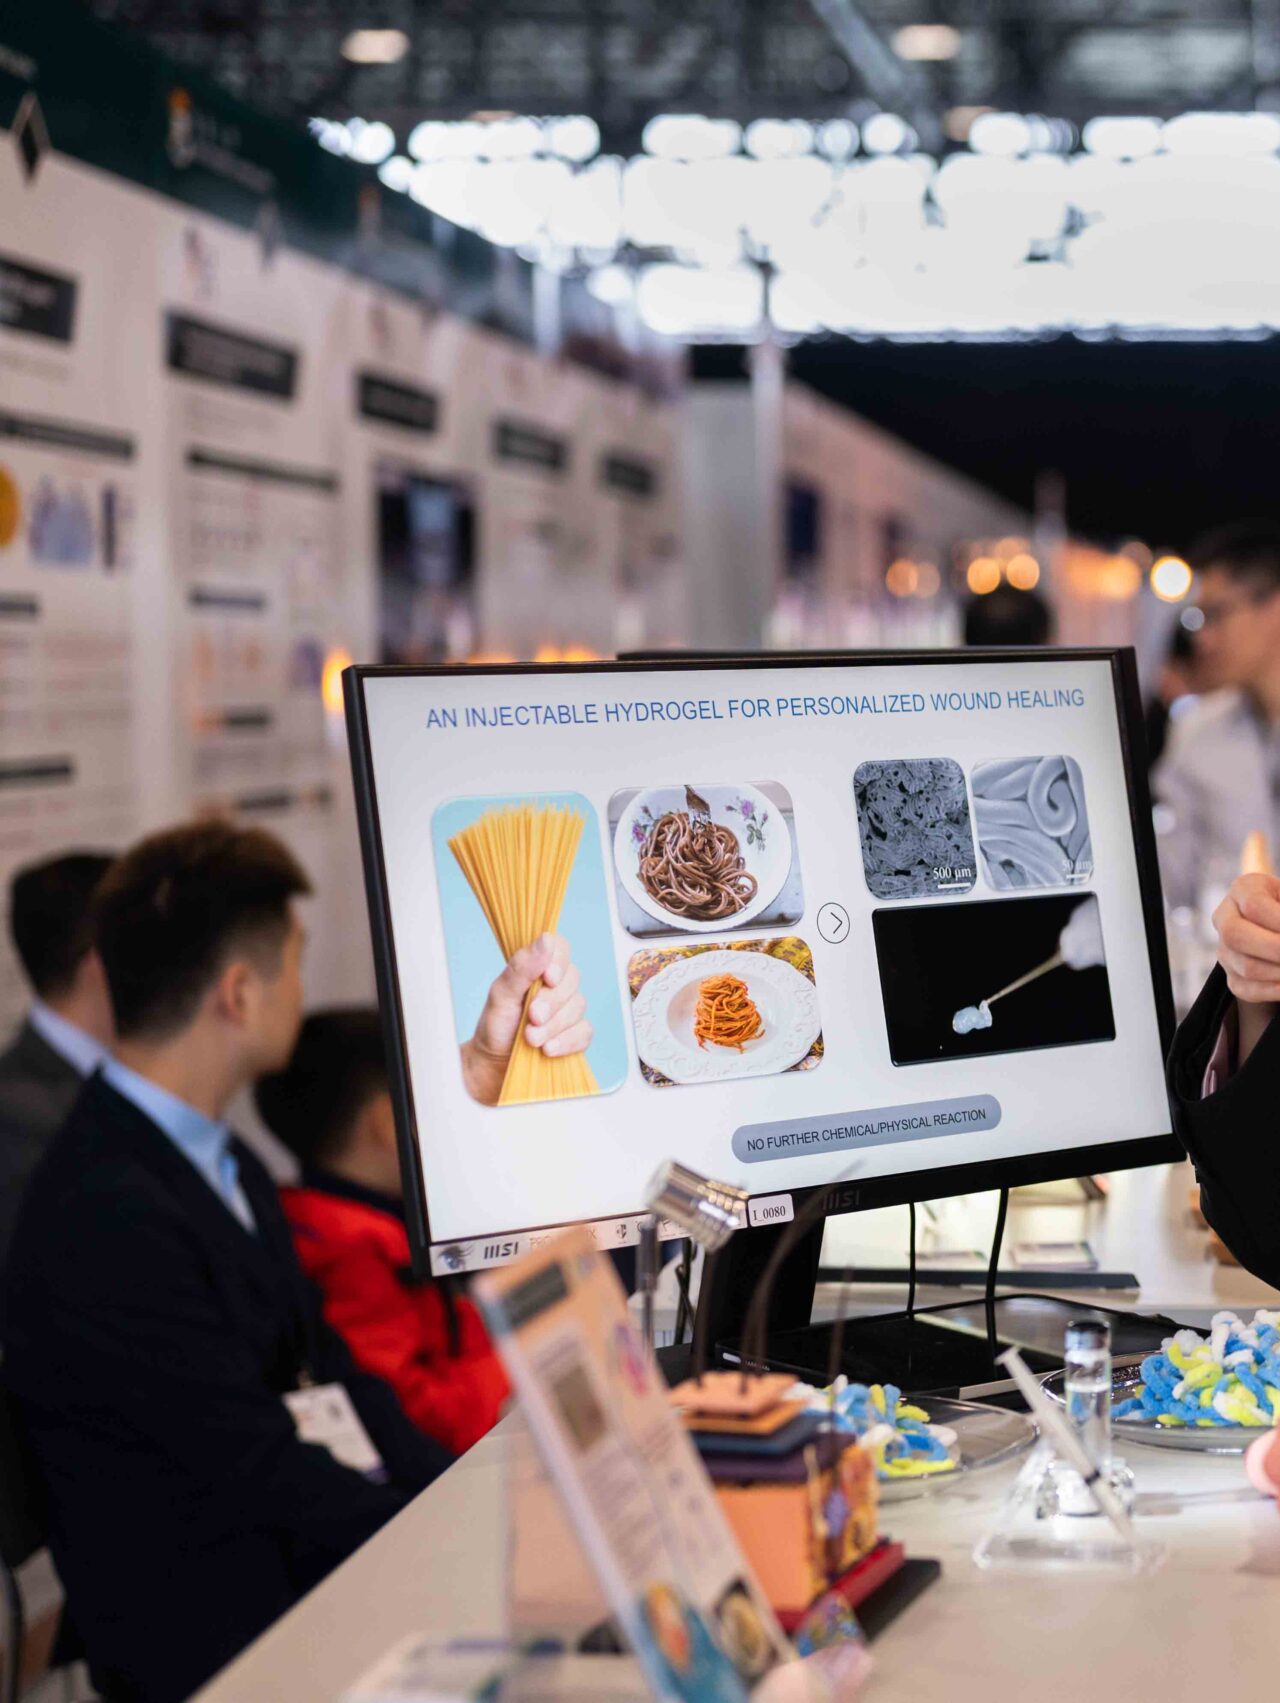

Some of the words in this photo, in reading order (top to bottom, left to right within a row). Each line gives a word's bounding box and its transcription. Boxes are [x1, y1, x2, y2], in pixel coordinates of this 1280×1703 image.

[426, 708, 458, 728] AN
[465, 704, 599, 727] INJECTABLE
[604, 700, 723, 722] HYDROGEL
[728, 699, 772, 718] FOR
[776, 694, 925, 717] PERSONALIZED
[930, 691, 1002, 712] WOUND
[1006, 688, 1085, 709] HEALING
[933, 868, 951, 880] 500
[747, 1138, 764, 1151] NO
[767, 1131, 820, 1149] FURTHER
[821, 1117, 933, 1142] CHEMICAL/PHYSICAL
[933, 1108, 987, 1126] REACTION
